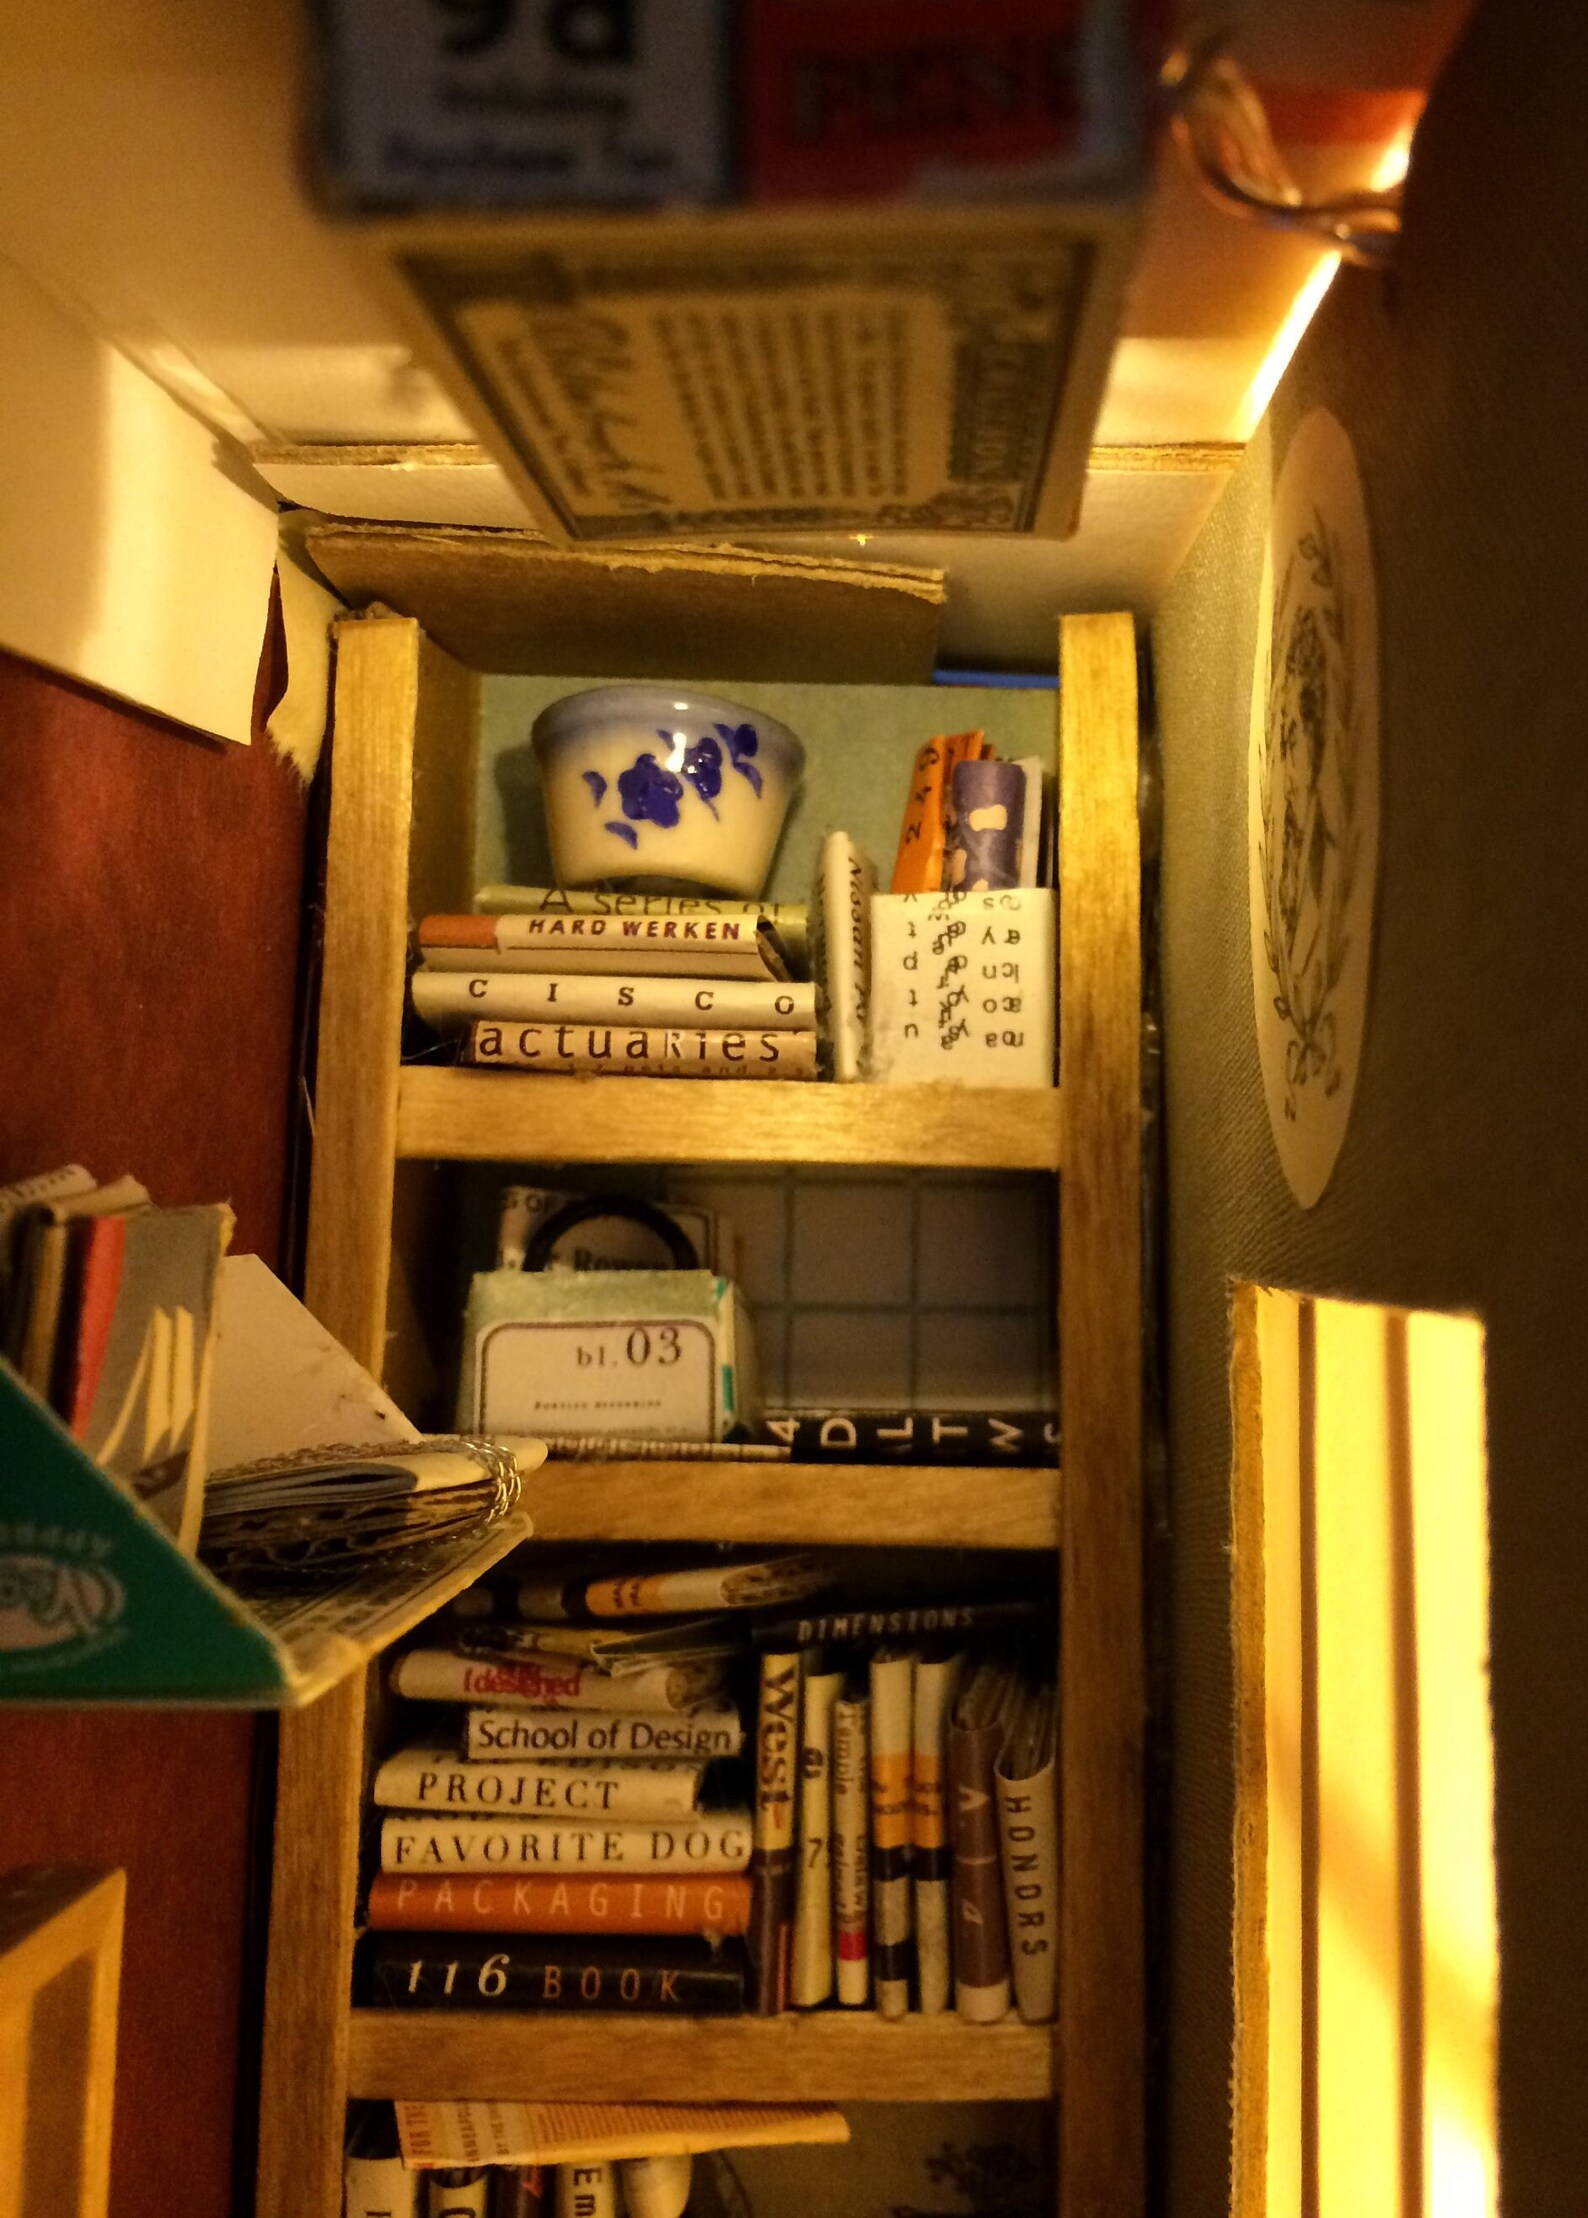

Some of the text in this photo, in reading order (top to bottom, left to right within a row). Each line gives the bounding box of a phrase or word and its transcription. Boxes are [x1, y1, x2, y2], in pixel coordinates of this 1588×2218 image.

[528, 918, 740, 941] HARD WERKEN
[797, 1606, 975, 1643] DIMENSIONS
[479, 1718, 732, 1756] School of Design
[417, 1771, 620, 1810] PROJECT
[395, 1829, 744, 1866] FAVORITE DOG
[1005, 1794, 1049, 1957] HONORS
[397, 1878, 725, 1922] PACKAGING
[408, 1953, 681, 2002] 116 BOOK
